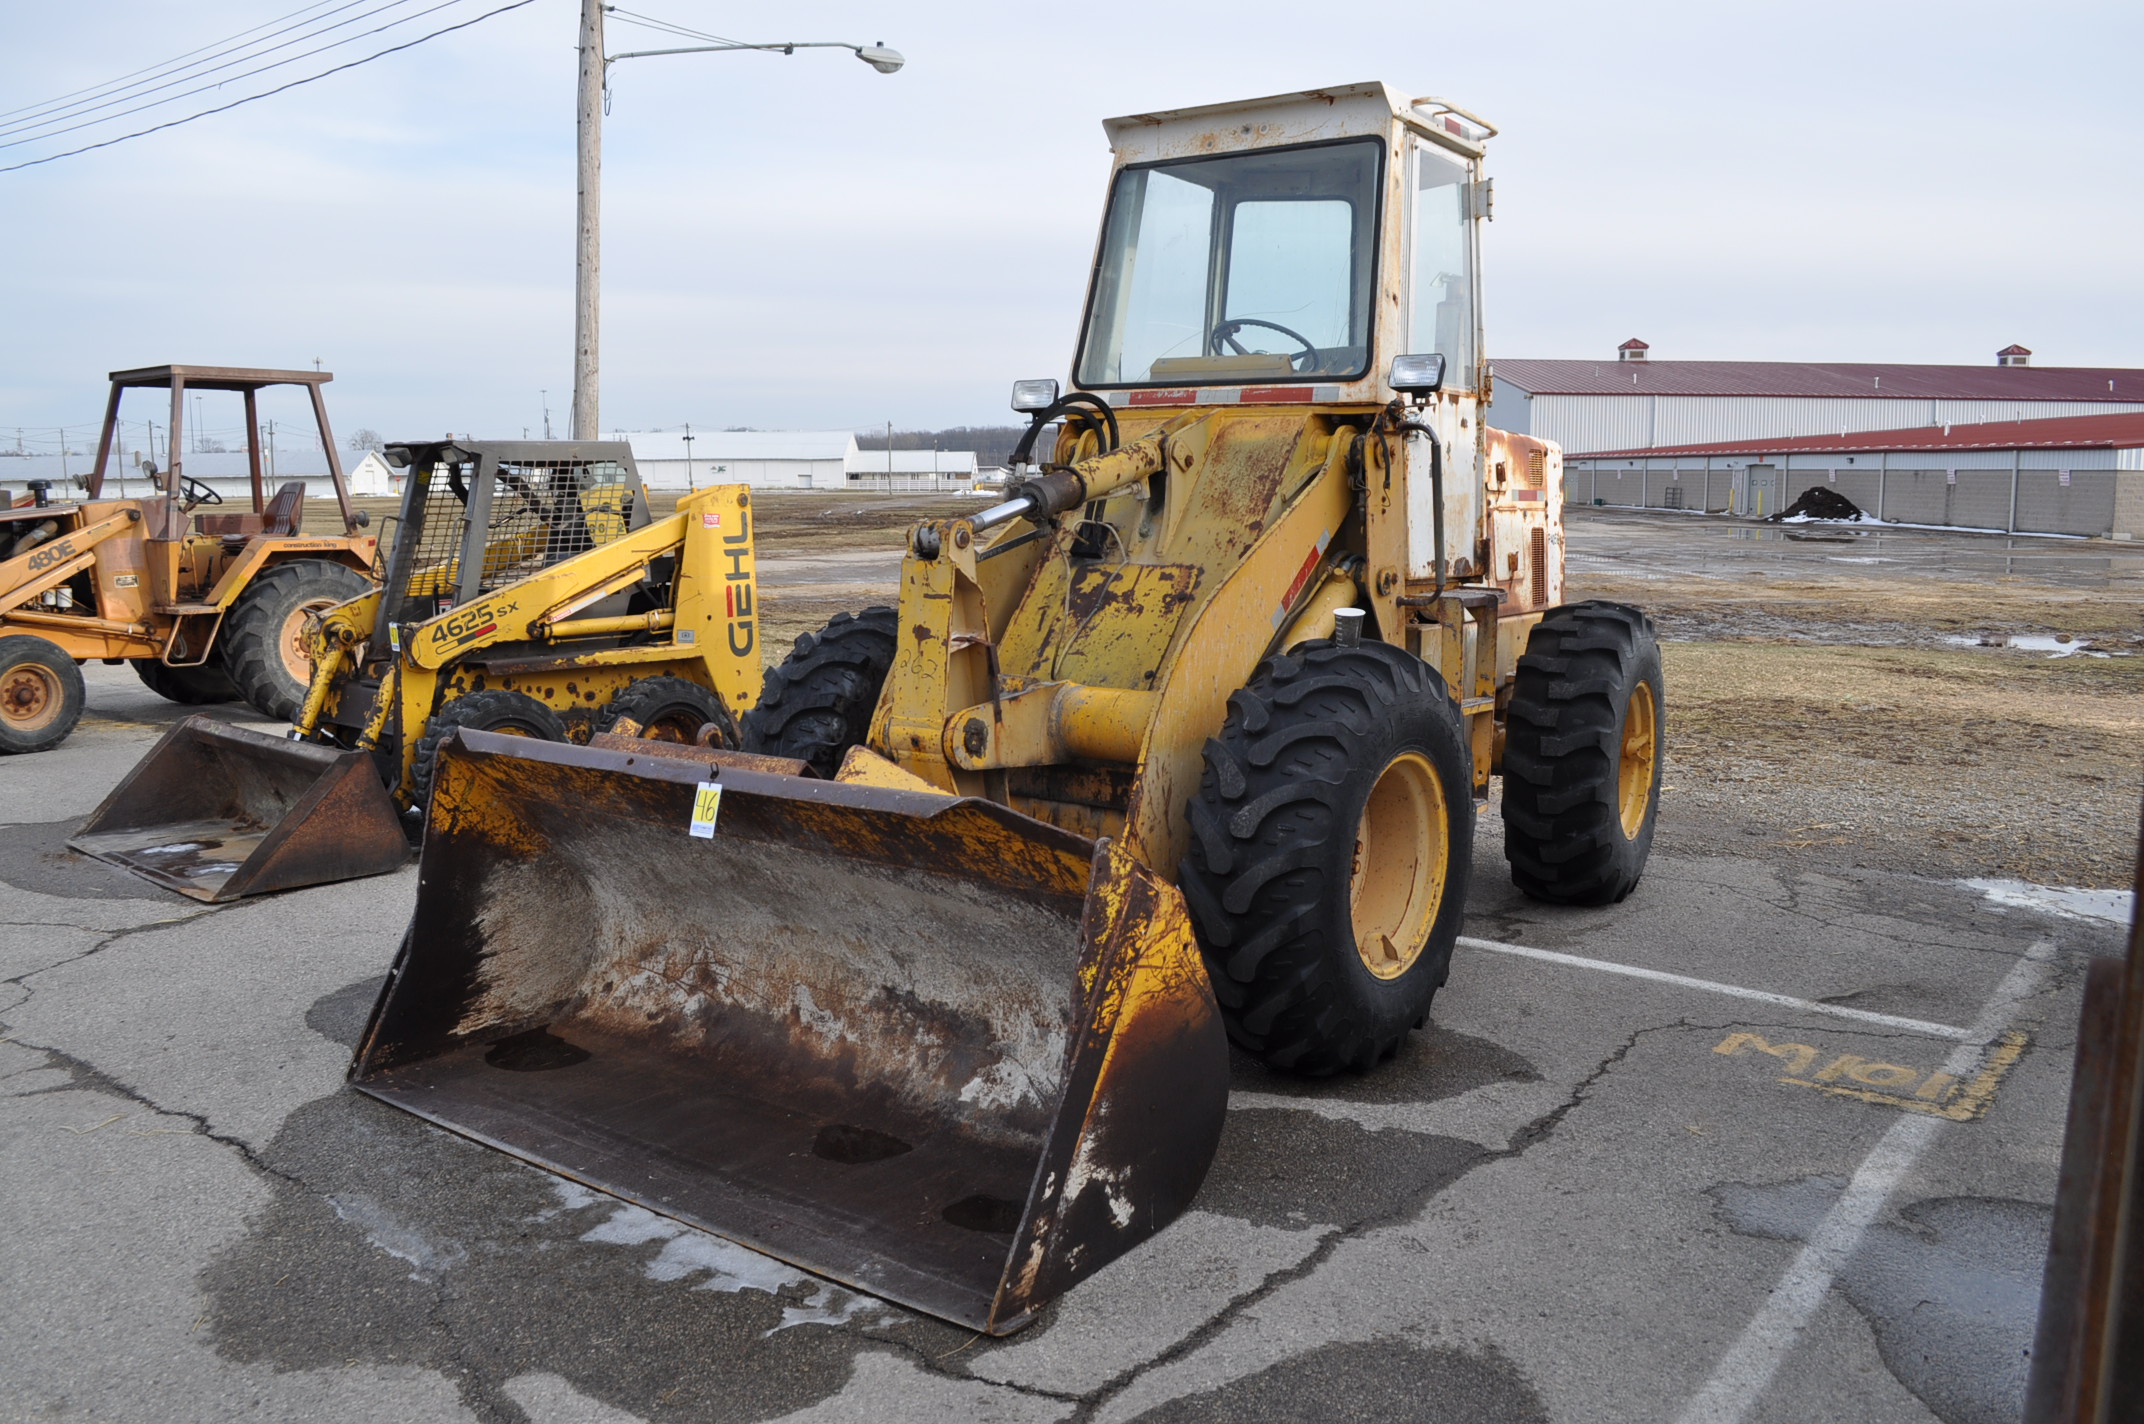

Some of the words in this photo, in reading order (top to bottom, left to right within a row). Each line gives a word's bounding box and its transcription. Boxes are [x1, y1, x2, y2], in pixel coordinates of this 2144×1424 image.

[27, 539, 77, 571] 480E
[283, 541, 322, 549] construction
[323, 541, 337, 549] king
[722, 511, 754, 658] GEHL
[431, 604, 494, 644] 4625
[900, 648, 938, 681] 262
[695, 790, 718, 822] 46
